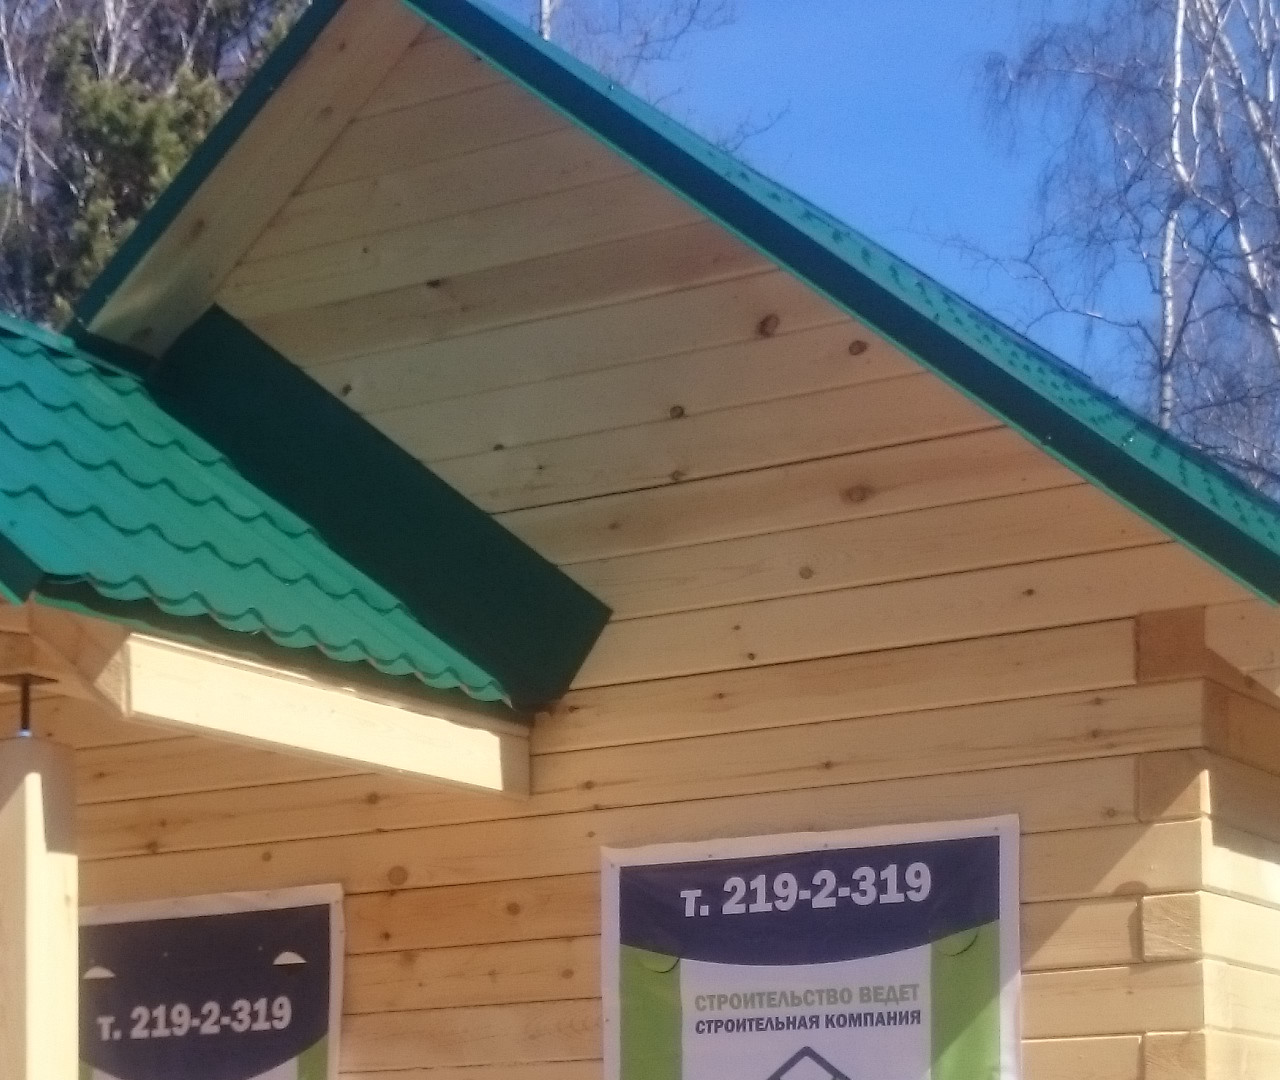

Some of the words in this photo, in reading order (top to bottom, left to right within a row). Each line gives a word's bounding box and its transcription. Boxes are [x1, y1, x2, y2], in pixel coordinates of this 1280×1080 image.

[722, 861, 933, 915] 219-2-319
[694, 987, 853, 1012] СТРОИТЕЛЬСТВО
[858, 983, 920, 1007] ВЕДЕТ
[129, 995, 293, 1040] 219-2-319
[694, 1014, 821, 1035] СТРОИТЕЛЬНАЯ
[824, 1009, 921, 1029] КОМПАНИЯ
